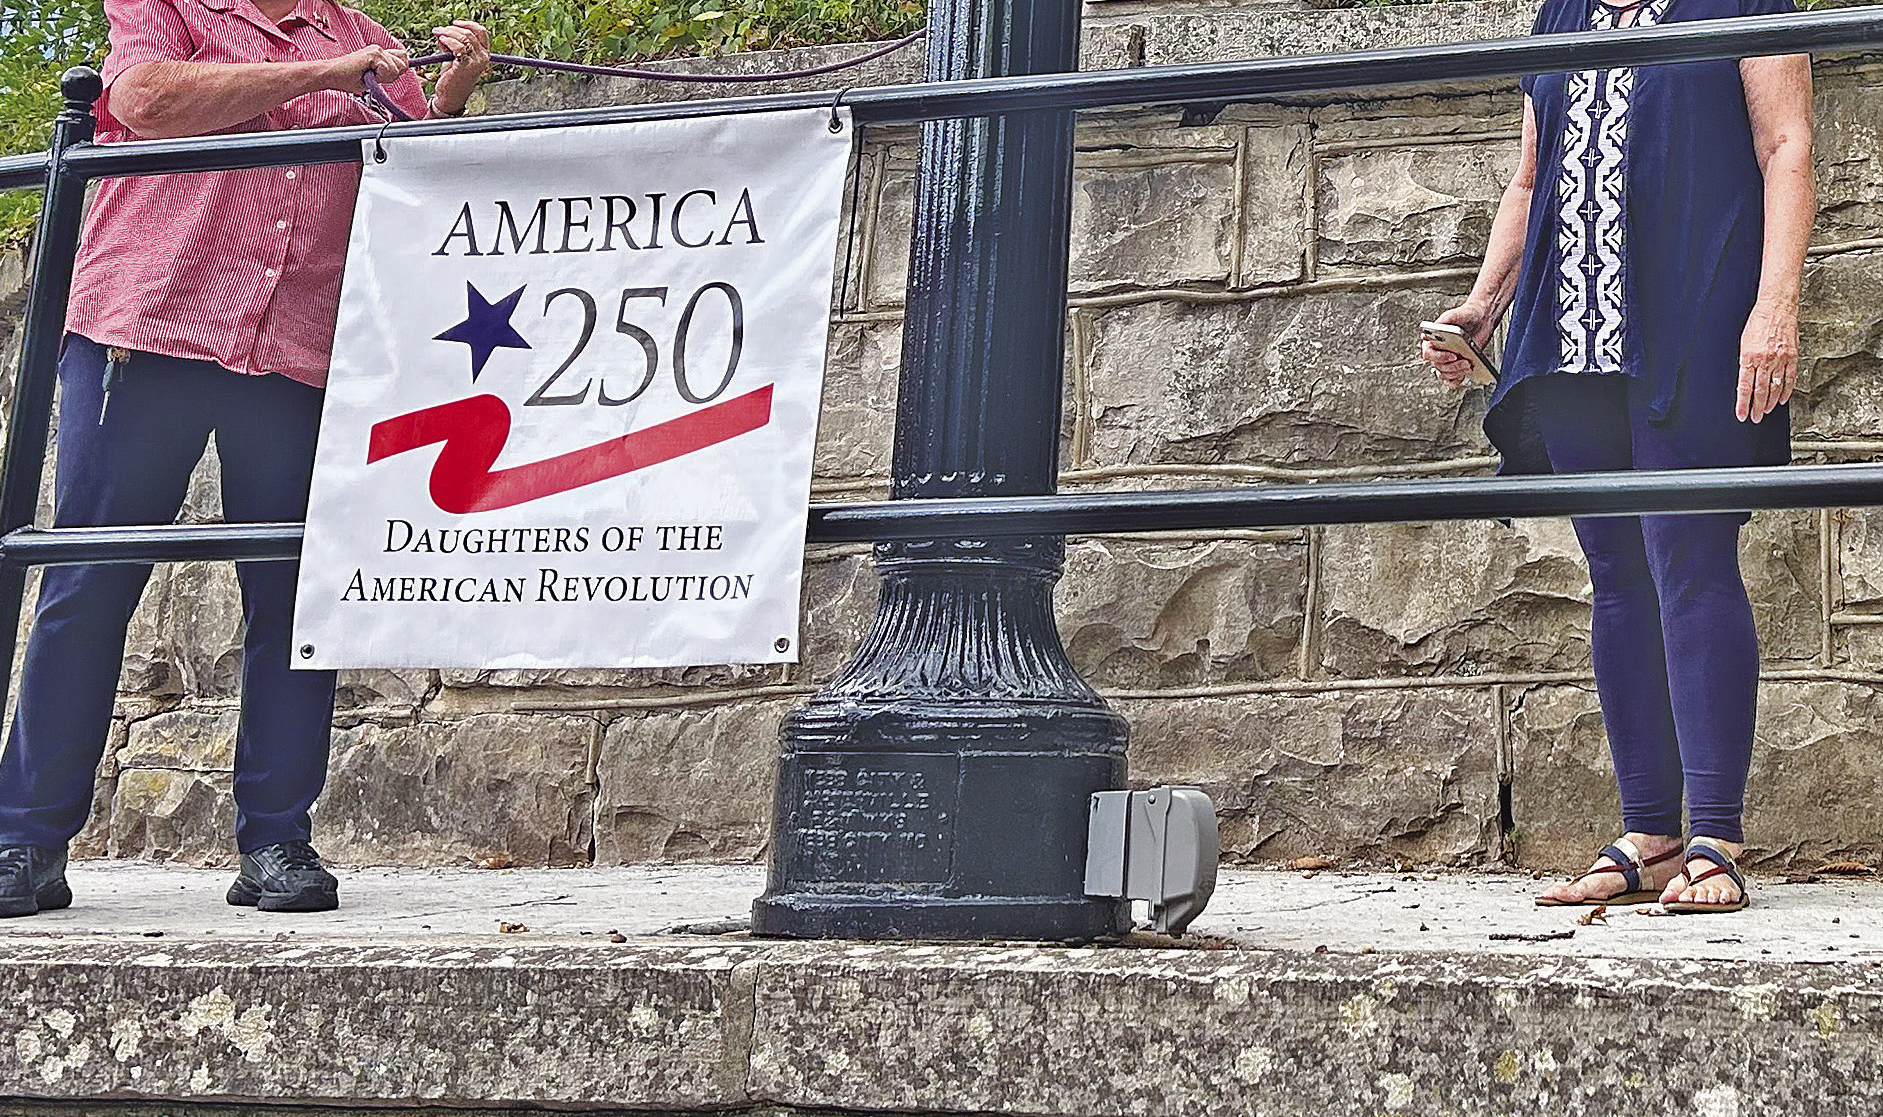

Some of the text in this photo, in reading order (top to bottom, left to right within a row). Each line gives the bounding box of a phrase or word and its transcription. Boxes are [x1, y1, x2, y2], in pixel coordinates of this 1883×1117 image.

[431, 187, 765, 256] AMERICA
[523, 281, 744, 406] 250
[383, 519, 723, 555] DAUGHTERS OF THE
[340, 568, 753, 602] AMERICAN REVOLUTION
